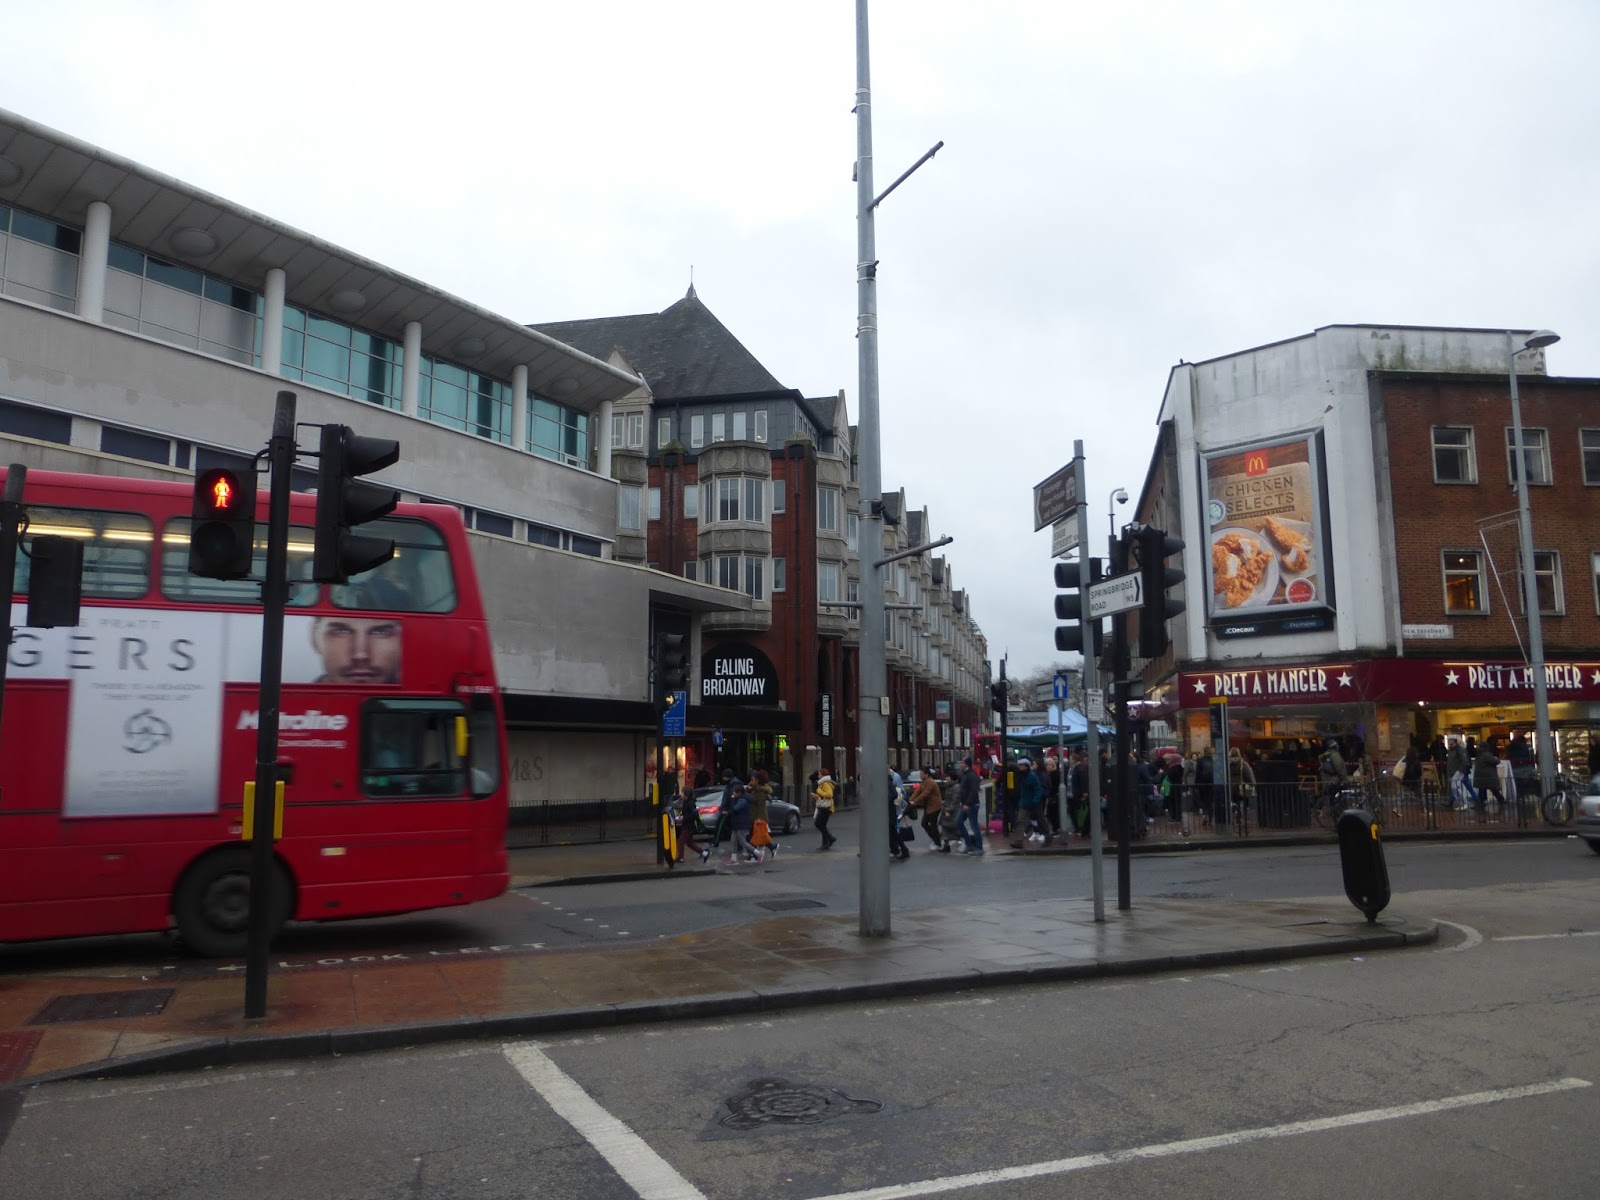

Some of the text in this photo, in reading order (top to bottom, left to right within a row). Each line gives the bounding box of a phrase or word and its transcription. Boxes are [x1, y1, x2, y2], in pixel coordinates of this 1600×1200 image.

[1225, 476, 1293, 497] CHICKEN
[1226, 492, 1295, 513] SELECTS
[1091, 580, 1133, 600] SPRINGBRIDGE
[1126, 594, 1134, 602] W5
[1091, 601, 1107, 611] ROAD
[1225, 627, 1255, 635] JCDecaux
[715, 658, 754, 676] EALING
[1468, 665, 1583, 689] PRET A MNGER
[703, 678, 766, 696] BROADWAY
[1214, 669, 1328, 696] PRET A MANGER
[278, 942, 546, 967] LOOK LEFT
